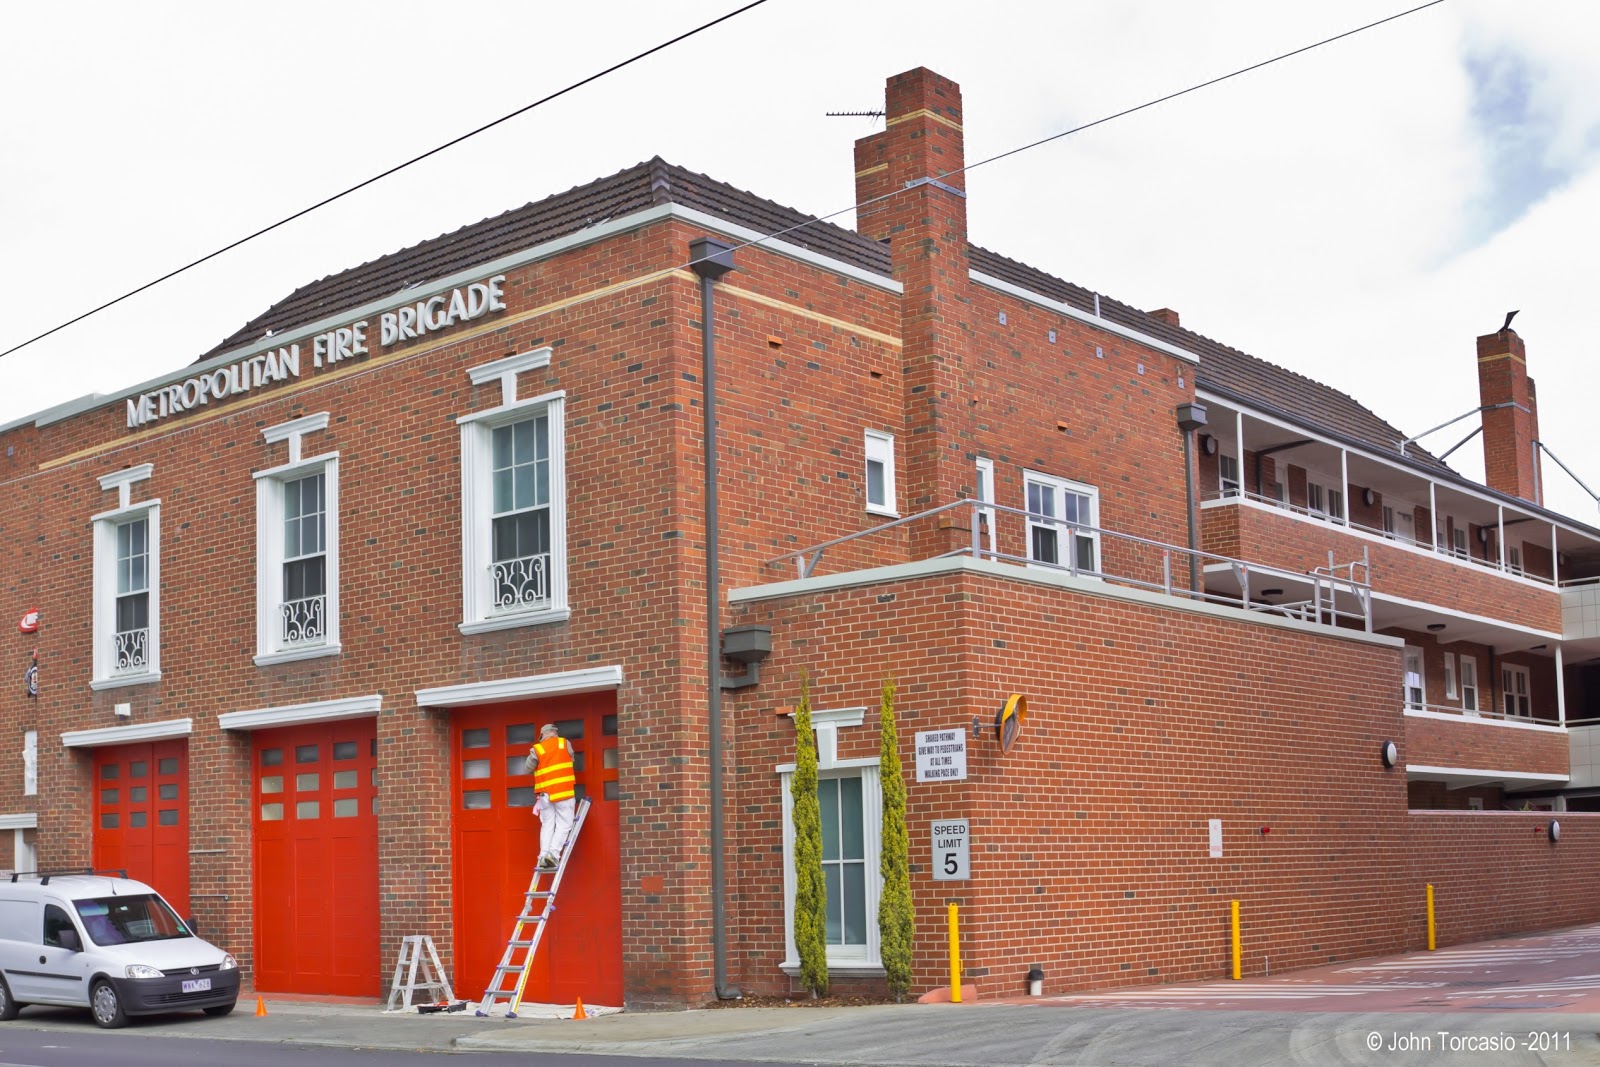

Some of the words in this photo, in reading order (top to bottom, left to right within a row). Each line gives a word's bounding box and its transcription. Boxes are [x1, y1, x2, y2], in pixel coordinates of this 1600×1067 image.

[126, 344, 300, 429] METROPOLITAN
[313, 320, 369, 368] FIRE
[380, 274, 508, 347] BRIGADE
[925, 733, 939, 743] SHARED
[939, 732, 956, 742] PATHWAY
[918, 746, 927, 755] GIVE
[935, 745, 940, 754] TO
[940, 743, 964, 754] PEDESTRIANS
[930, 757, 934, 766] AT
[941, 756, 952, 765] TIMES
[924, 769, 940, 778] WALKING
[940, 768, 950, 777] PACE
[950, 768, 959, 777] ONLY
[934, 825, 966, 836] SPEED
[938, 838, 962, 849] LIMIT
[944, 852, 958, 875] 5
